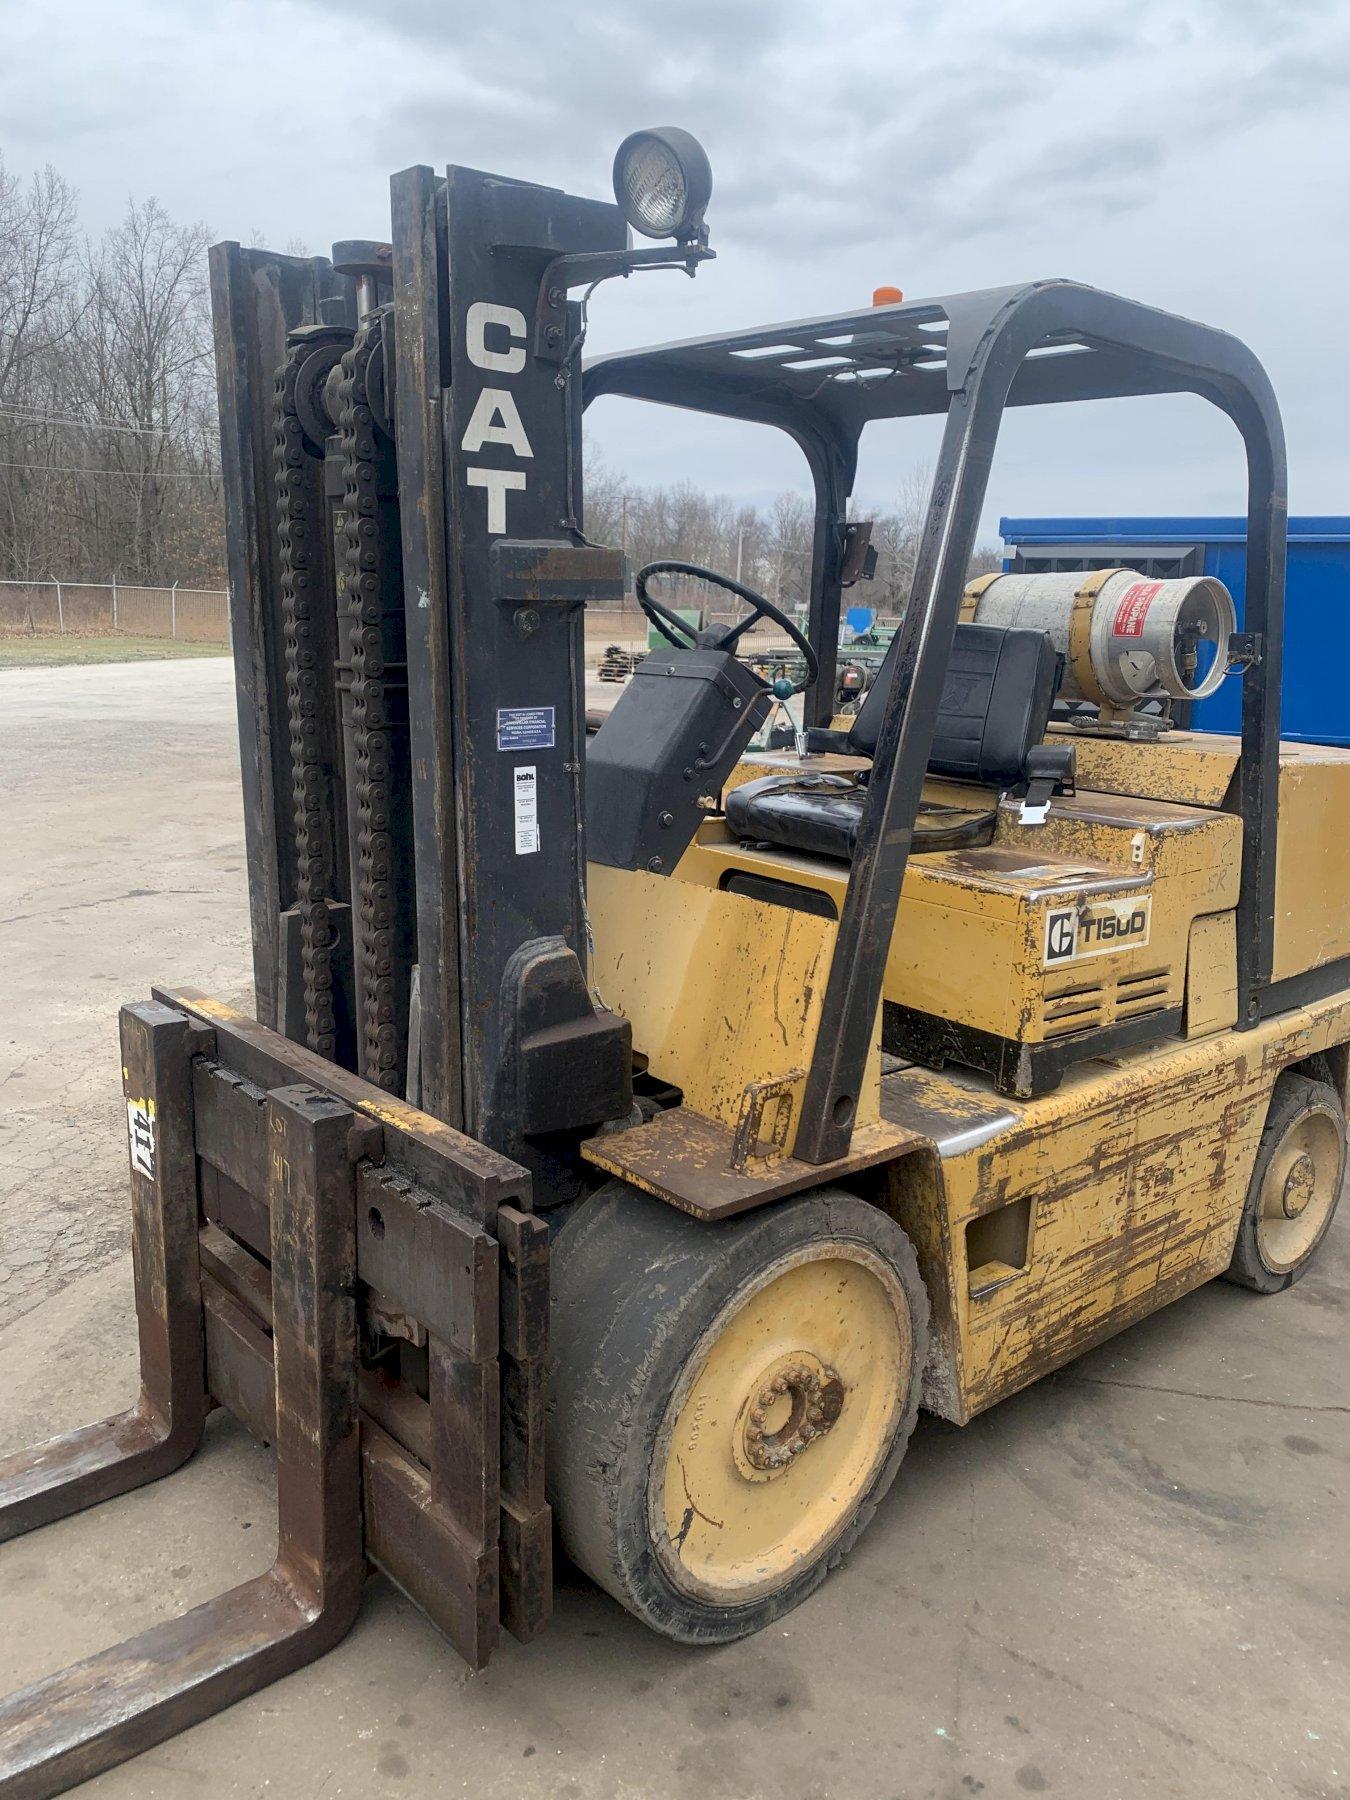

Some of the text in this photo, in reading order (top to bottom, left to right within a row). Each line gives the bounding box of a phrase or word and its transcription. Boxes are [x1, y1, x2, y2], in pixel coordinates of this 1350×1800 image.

[461, 302, 534, 534] CAT
[1126, 596, 1146, 634] PROPANE
[273, 1149, 291, 1194] 417
